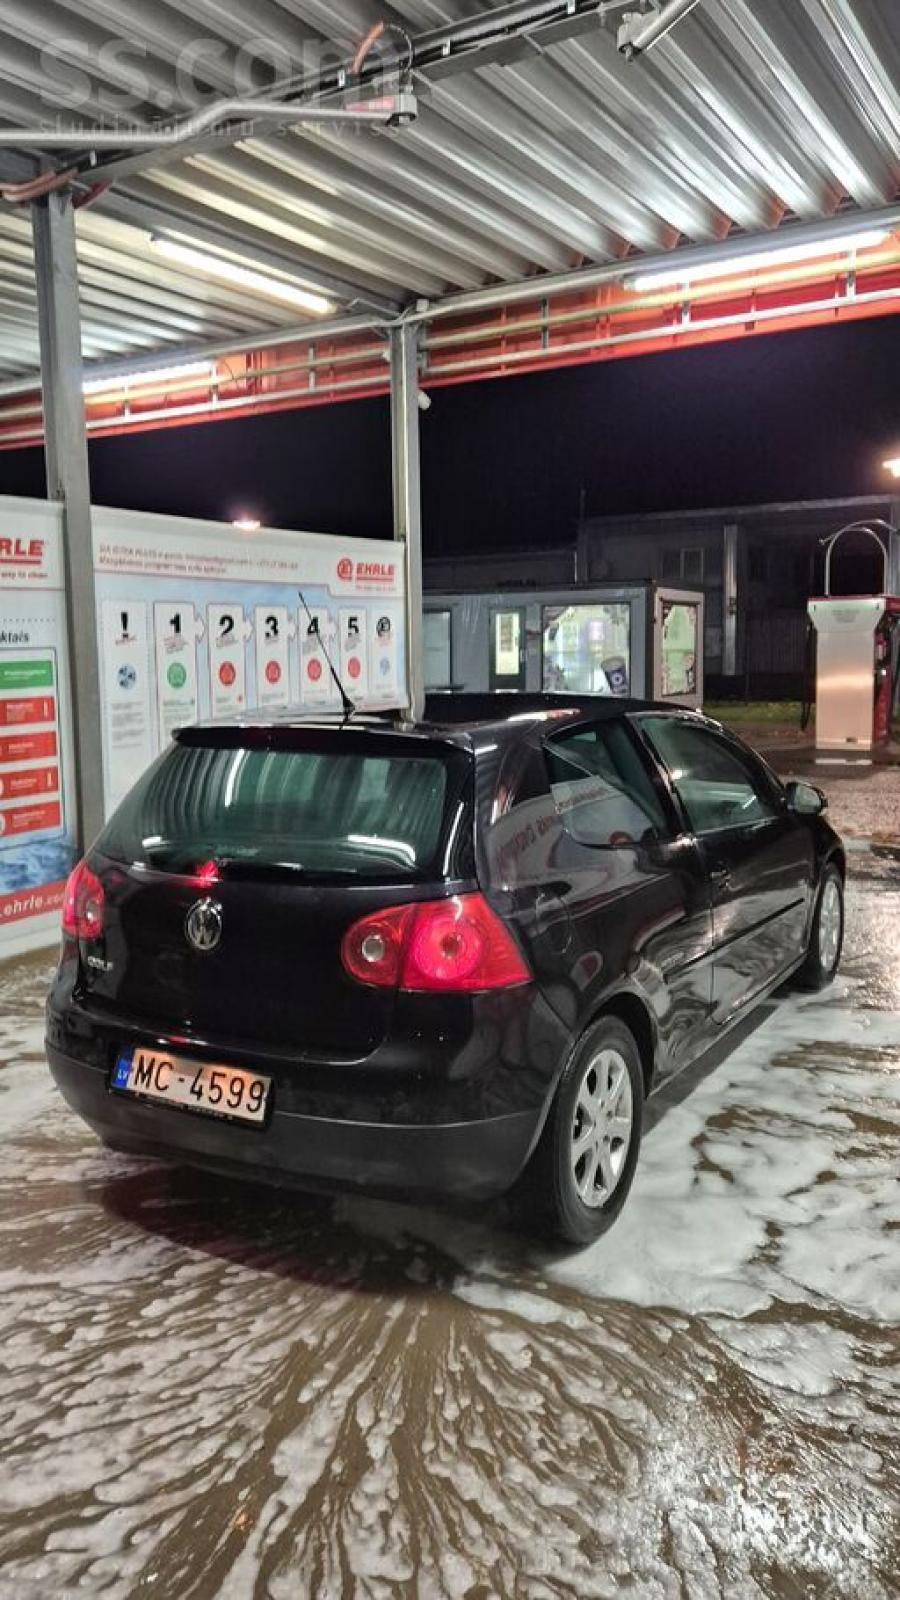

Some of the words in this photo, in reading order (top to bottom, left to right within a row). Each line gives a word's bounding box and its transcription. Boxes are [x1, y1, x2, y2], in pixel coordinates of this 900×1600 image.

[356, 562, 395, 576] EHRLE
[169, 613, 181, 634] 1
[219, 614, 235, 638] 2
[265, 616, 279, 638] 3
[307, 616, 320, 636] 4
[347, 616, 359, 636] 5
